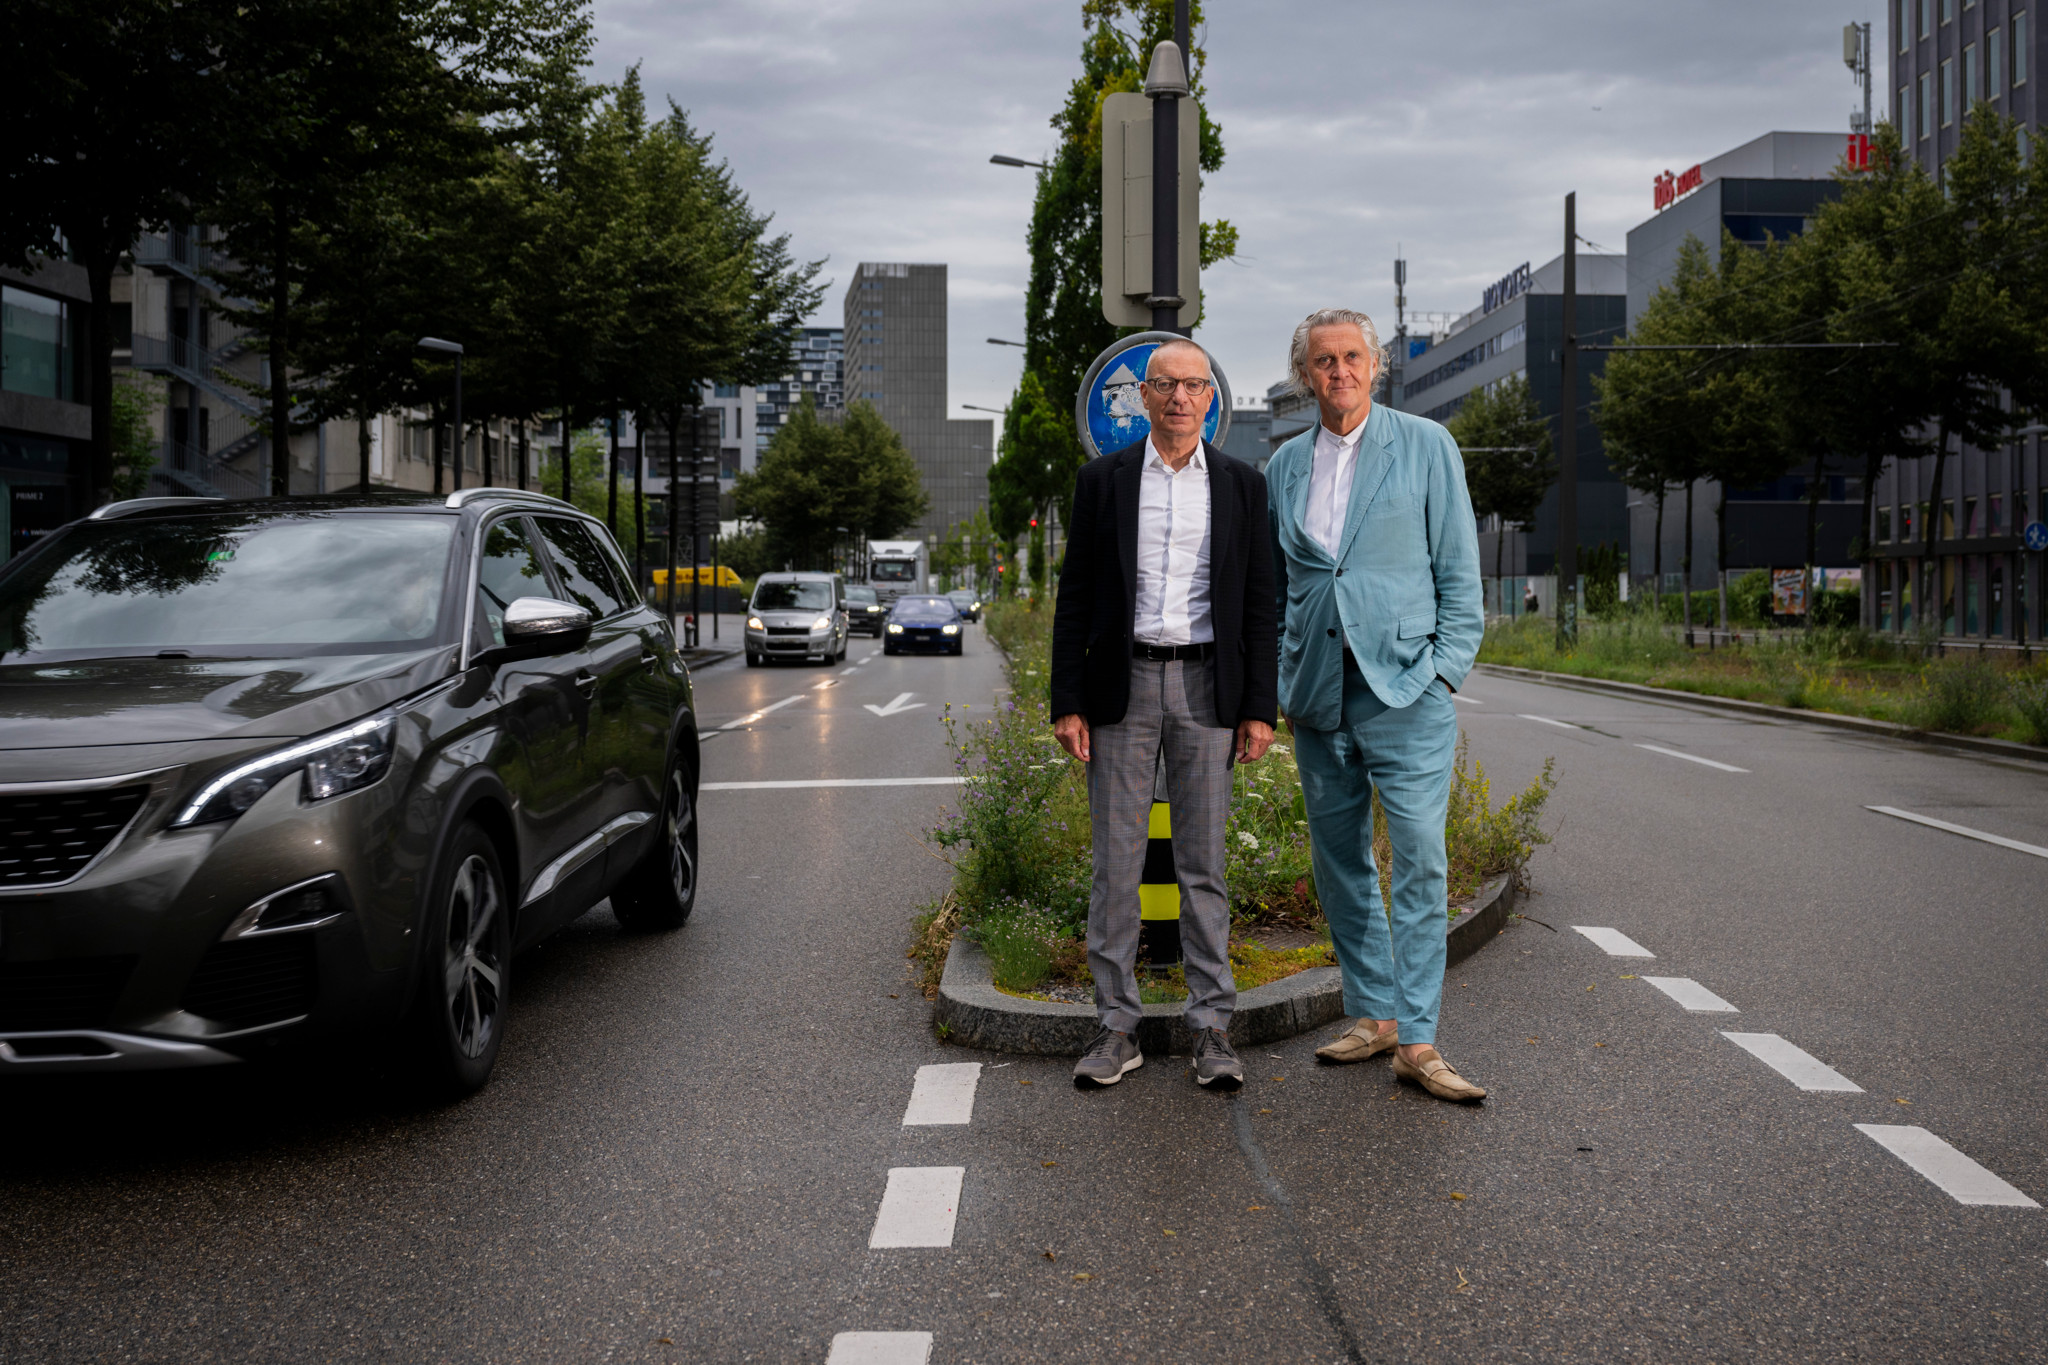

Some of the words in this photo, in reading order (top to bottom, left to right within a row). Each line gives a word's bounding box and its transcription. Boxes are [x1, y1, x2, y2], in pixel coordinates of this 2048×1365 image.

[1654, 170, 1675, 210] ibis
[1483, 262, 1533, 314] NOVOTEL
[16, 492, 37, 500] PRIME
[38, 492, 44, 500] 2
